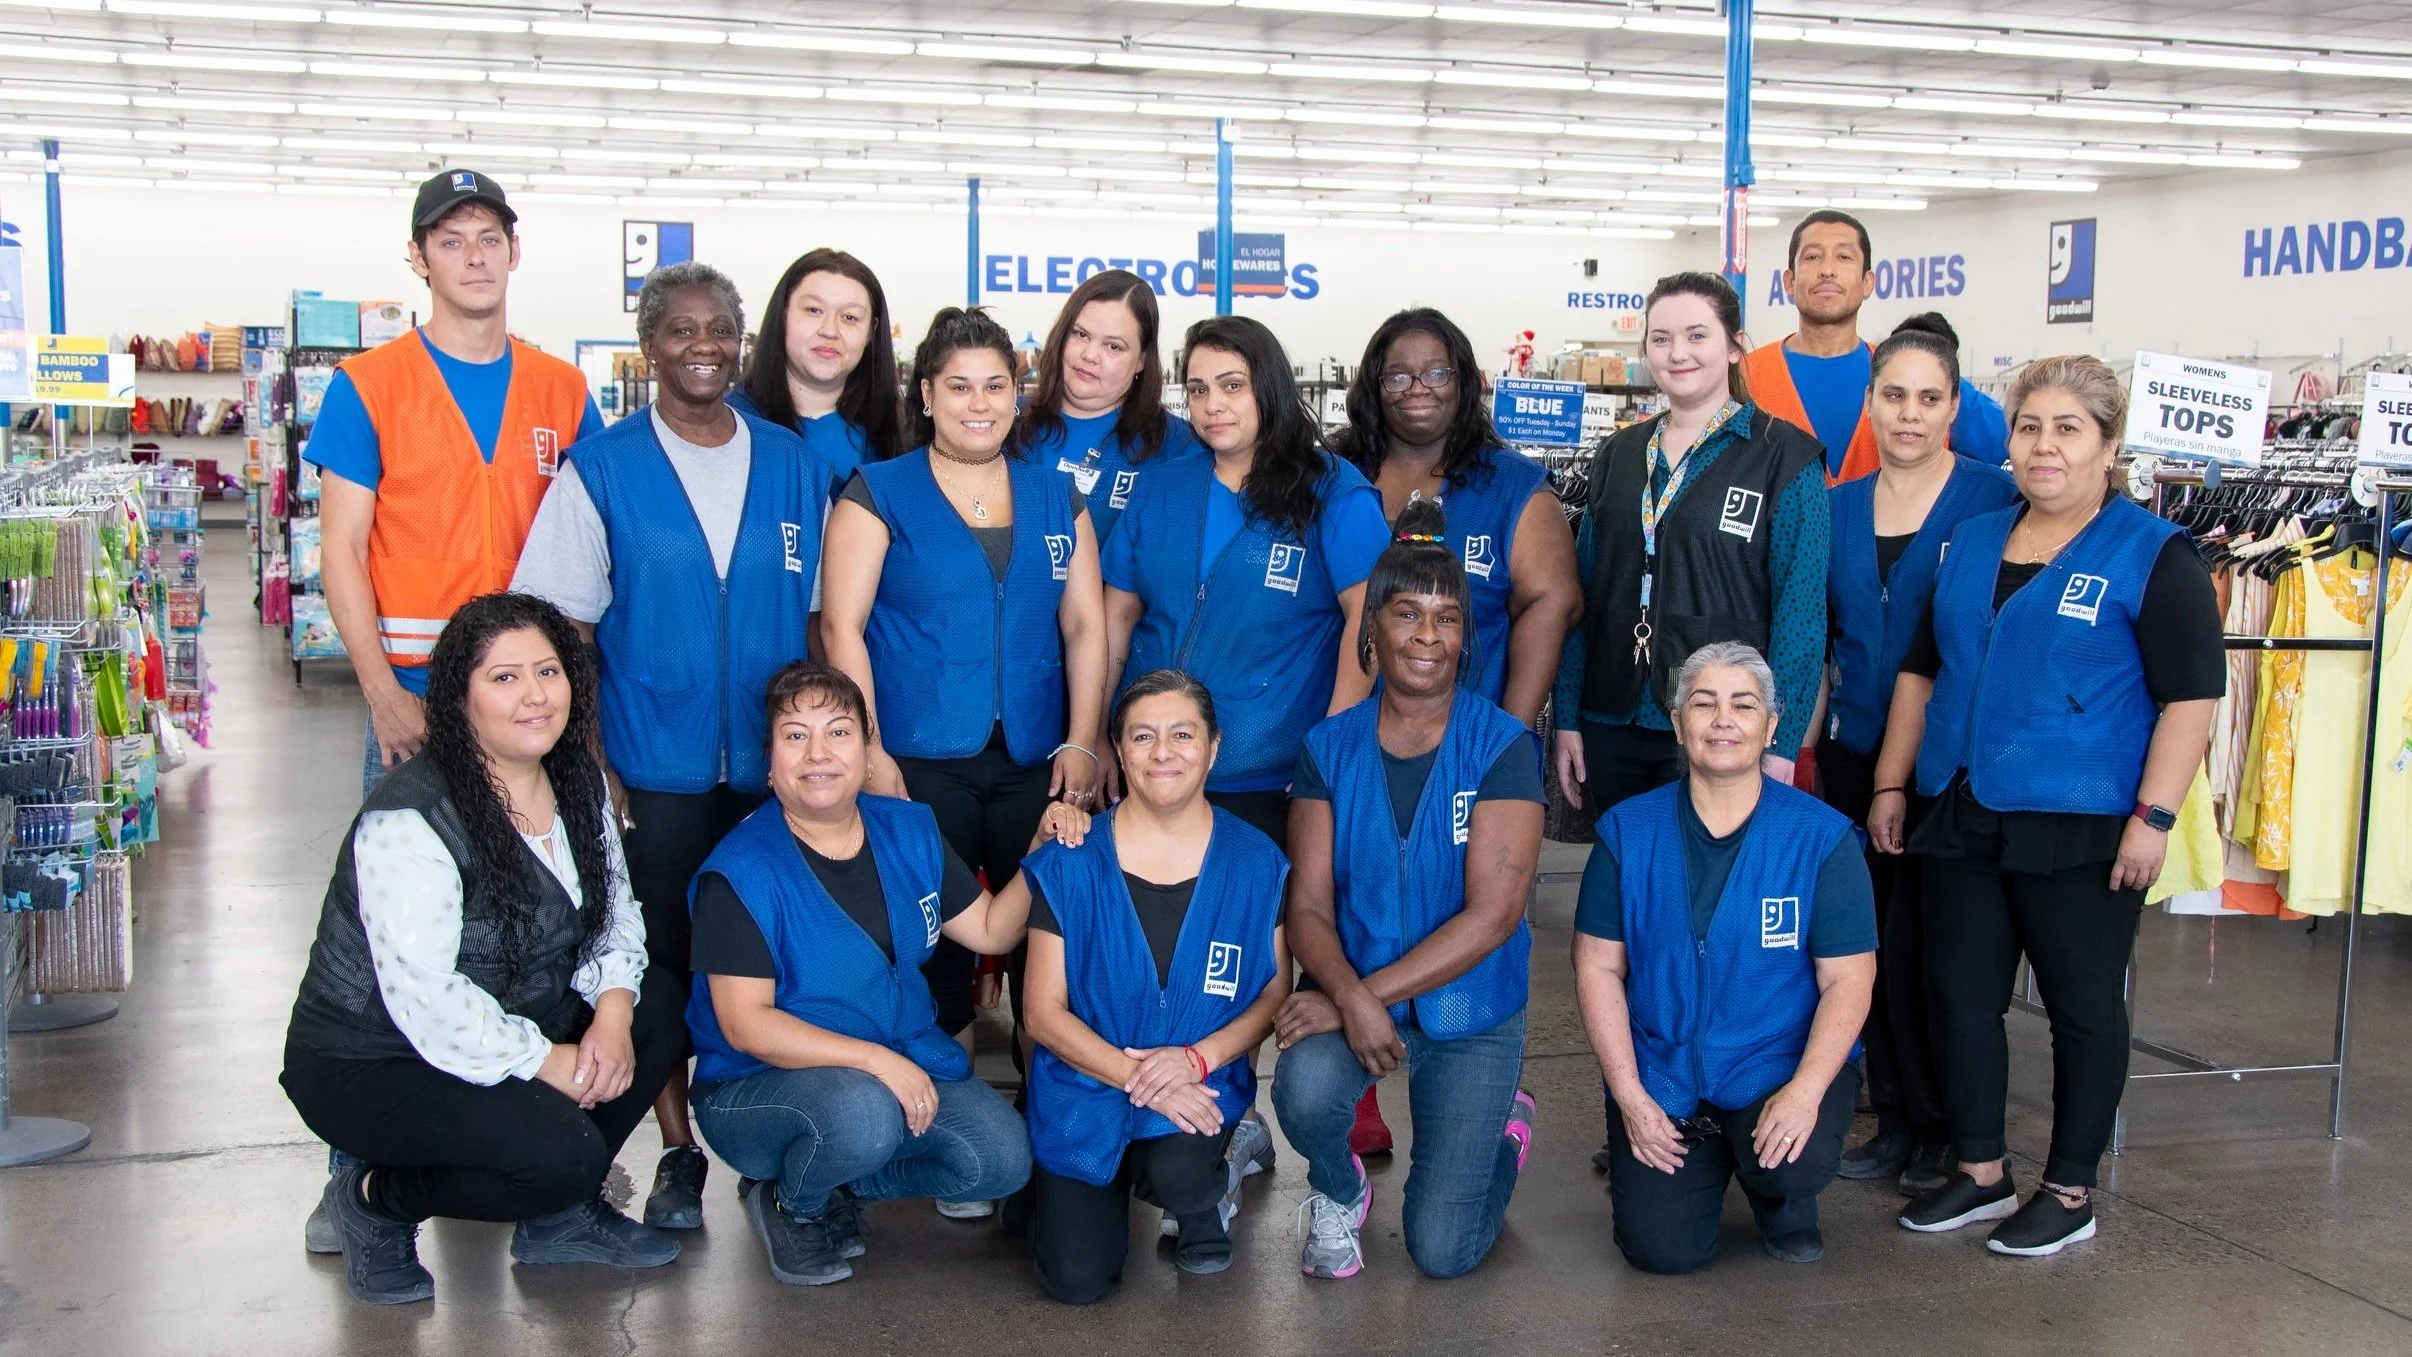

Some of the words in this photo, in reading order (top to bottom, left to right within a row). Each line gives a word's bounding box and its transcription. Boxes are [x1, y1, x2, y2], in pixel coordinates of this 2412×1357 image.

[1240, 247, 1251, 257] EL
[1252, 248, 1281, 257] HOGAR
[2243, 217, 2412, 278] HANDB
[1202, 258, 1281, 272] HOEWARES
[1768, 254, 1966, 306] AORIES
[1567, 292, 1644, 310] RESTRO
[2048, 299, 2092, 322] goodwill
[40, 355, 99, 367] BAMBOO
[38, 370, 84, 382] LLOWS
[2183, 363, 2227, 380] WOMENS
[1507, 381, 1530, 390] COLOR
[1555, 384, 1574, 393] WEEK
[2147, 381, 2253, 411] SLEEVELESS
[1331, 403, 1346, 413] PA
[1515, 396, 1564, 416] BLUE
[1583, 405, 1611, 417] ANTS
[1498, 415, 1513, 424] 50%
[1526, 417, 1551, 428] Tuesday
[1554, 419, 1577, 429] Sunday
[2159, 404, 2235, 439] TOPS
[1507, 426, 1516, 434] $1
[1517, 427, 1533, 435] Each
[1542, 429, 1567, 438] Monday
[2143, 431, 2187, 448] Playeras
[2189, 437, 2204, 451] sin
[2206, 442, 2242, 459] manga
[1722, 521, 1752, 533] goodwill
[2060, 605, 2095, 617] goodwill
[1764, 934, 1796, 946] goodwill
[1206, 983, 1236, 993] goodwill
